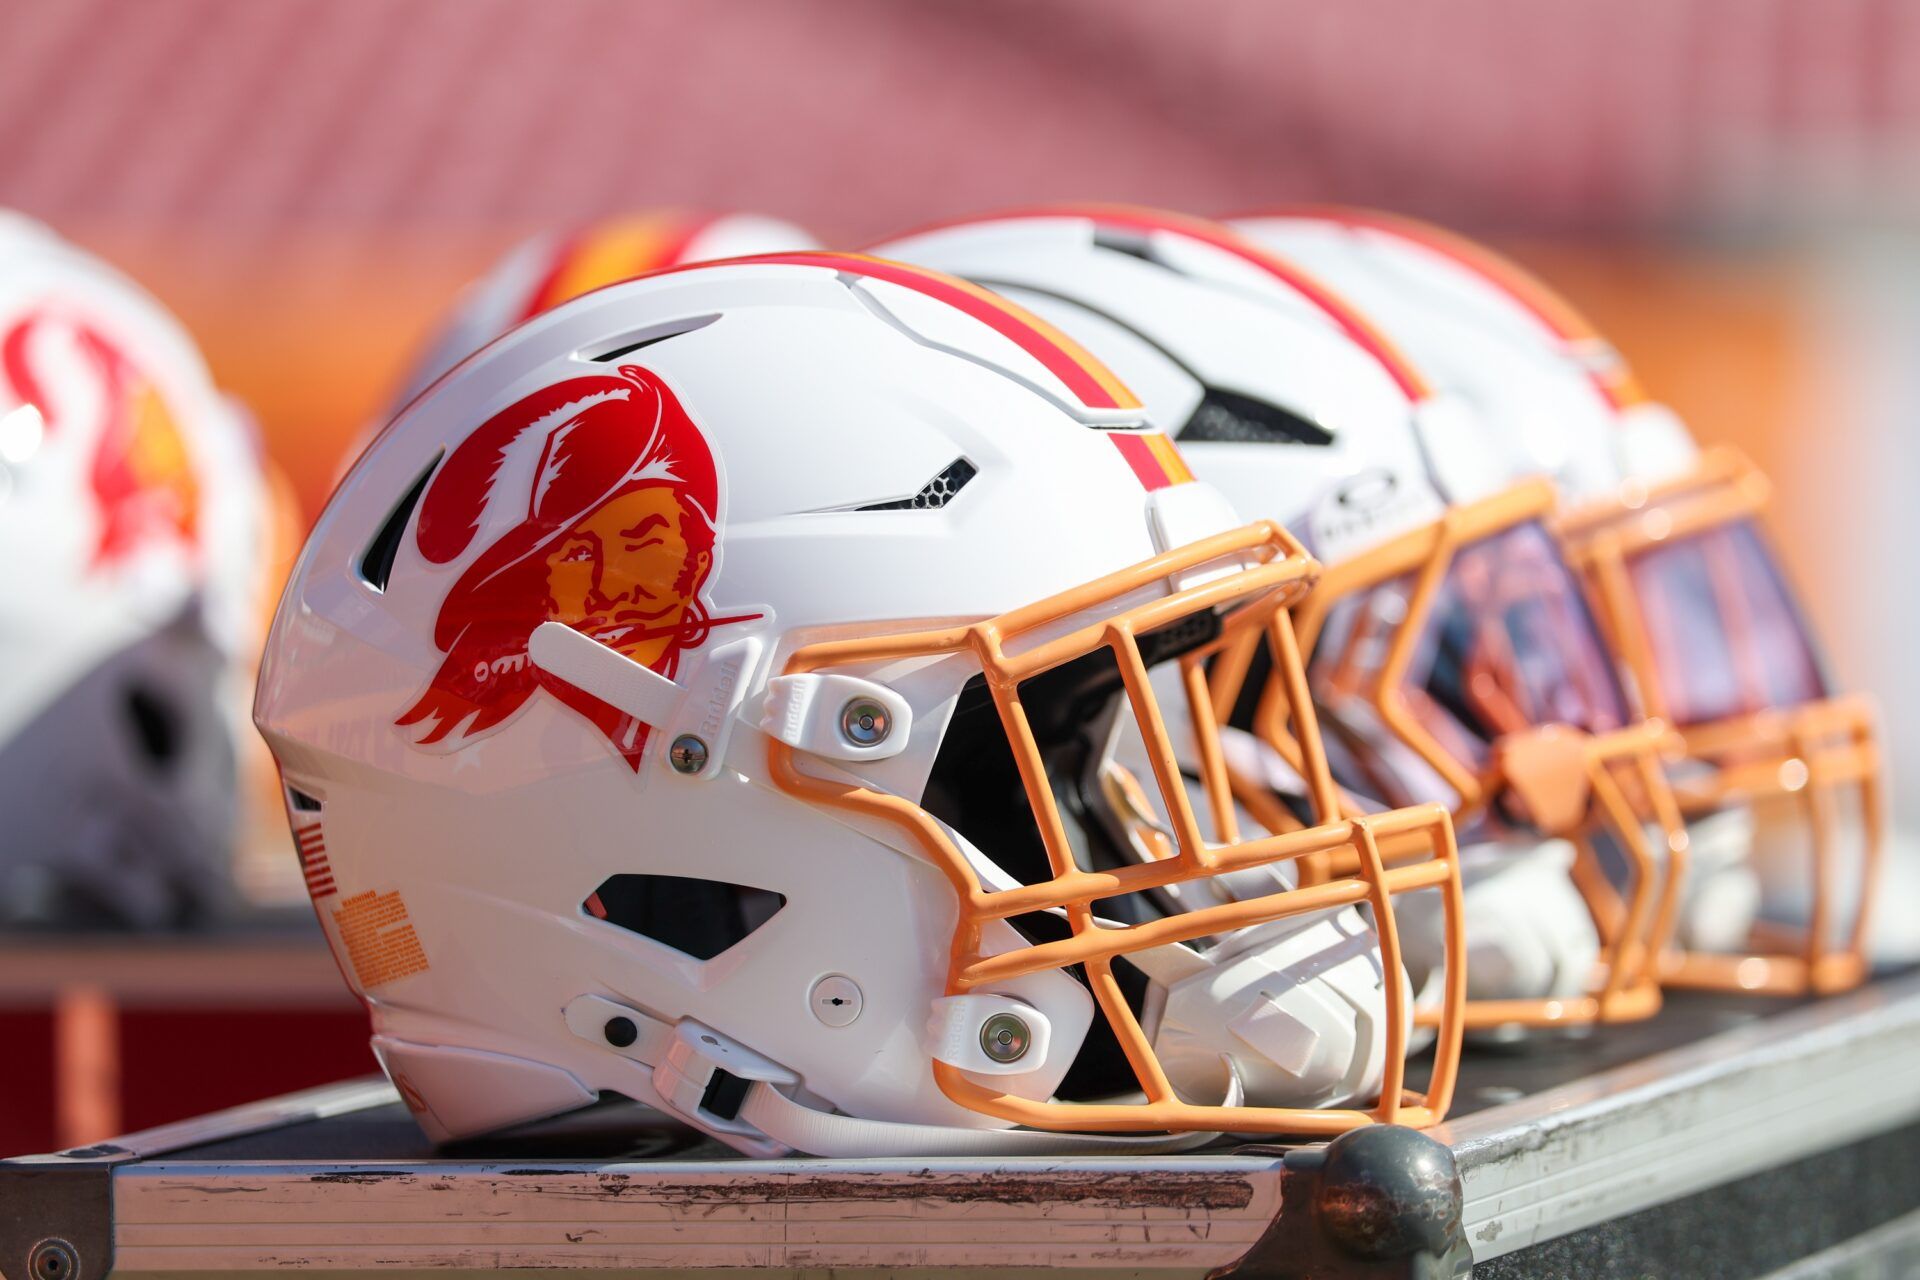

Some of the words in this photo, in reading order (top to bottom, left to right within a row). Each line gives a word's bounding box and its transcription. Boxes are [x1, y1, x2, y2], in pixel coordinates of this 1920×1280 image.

[701, 661, 738, 739] Riddell
[786, 679, 807, 740] Riddell
[946, 1001, 967, 1058] Riddell
